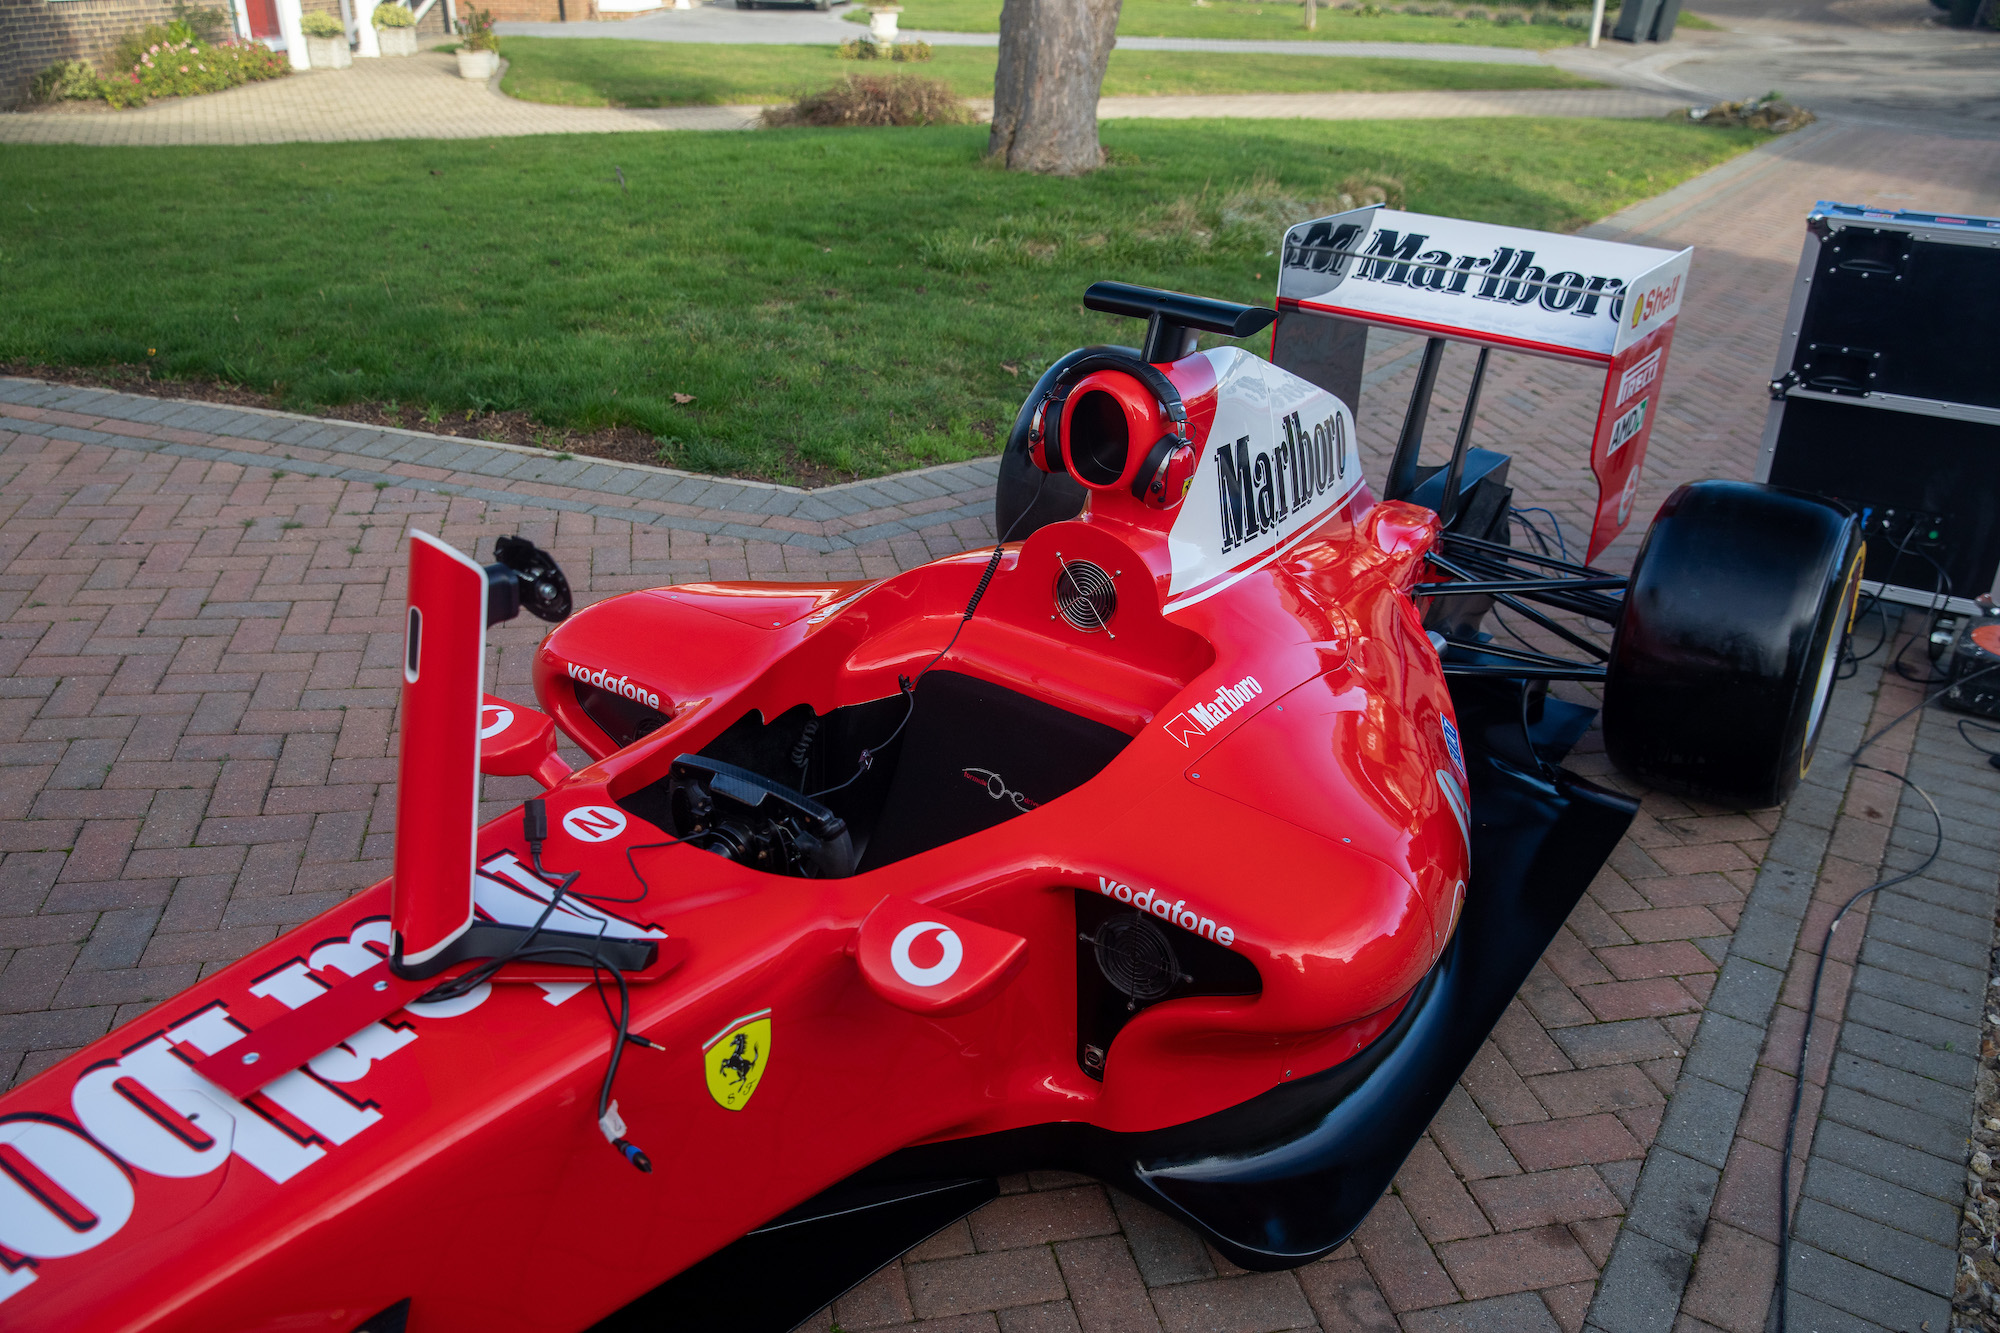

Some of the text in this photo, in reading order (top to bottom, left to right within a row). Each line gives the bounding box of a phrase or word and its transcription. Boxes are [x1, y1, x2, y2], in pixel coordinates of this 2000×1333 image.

[1642, 274, 1682, 322] Shell
[1615, 346, 1663, 409] PIRELLI
[1214, 410, 1347, 554] Marlboro
[567, 662, 660, 710] vodafone
[1187, 675, 1263, 732] Marlboro
[1099, 876, 1235, 946] vodafone
